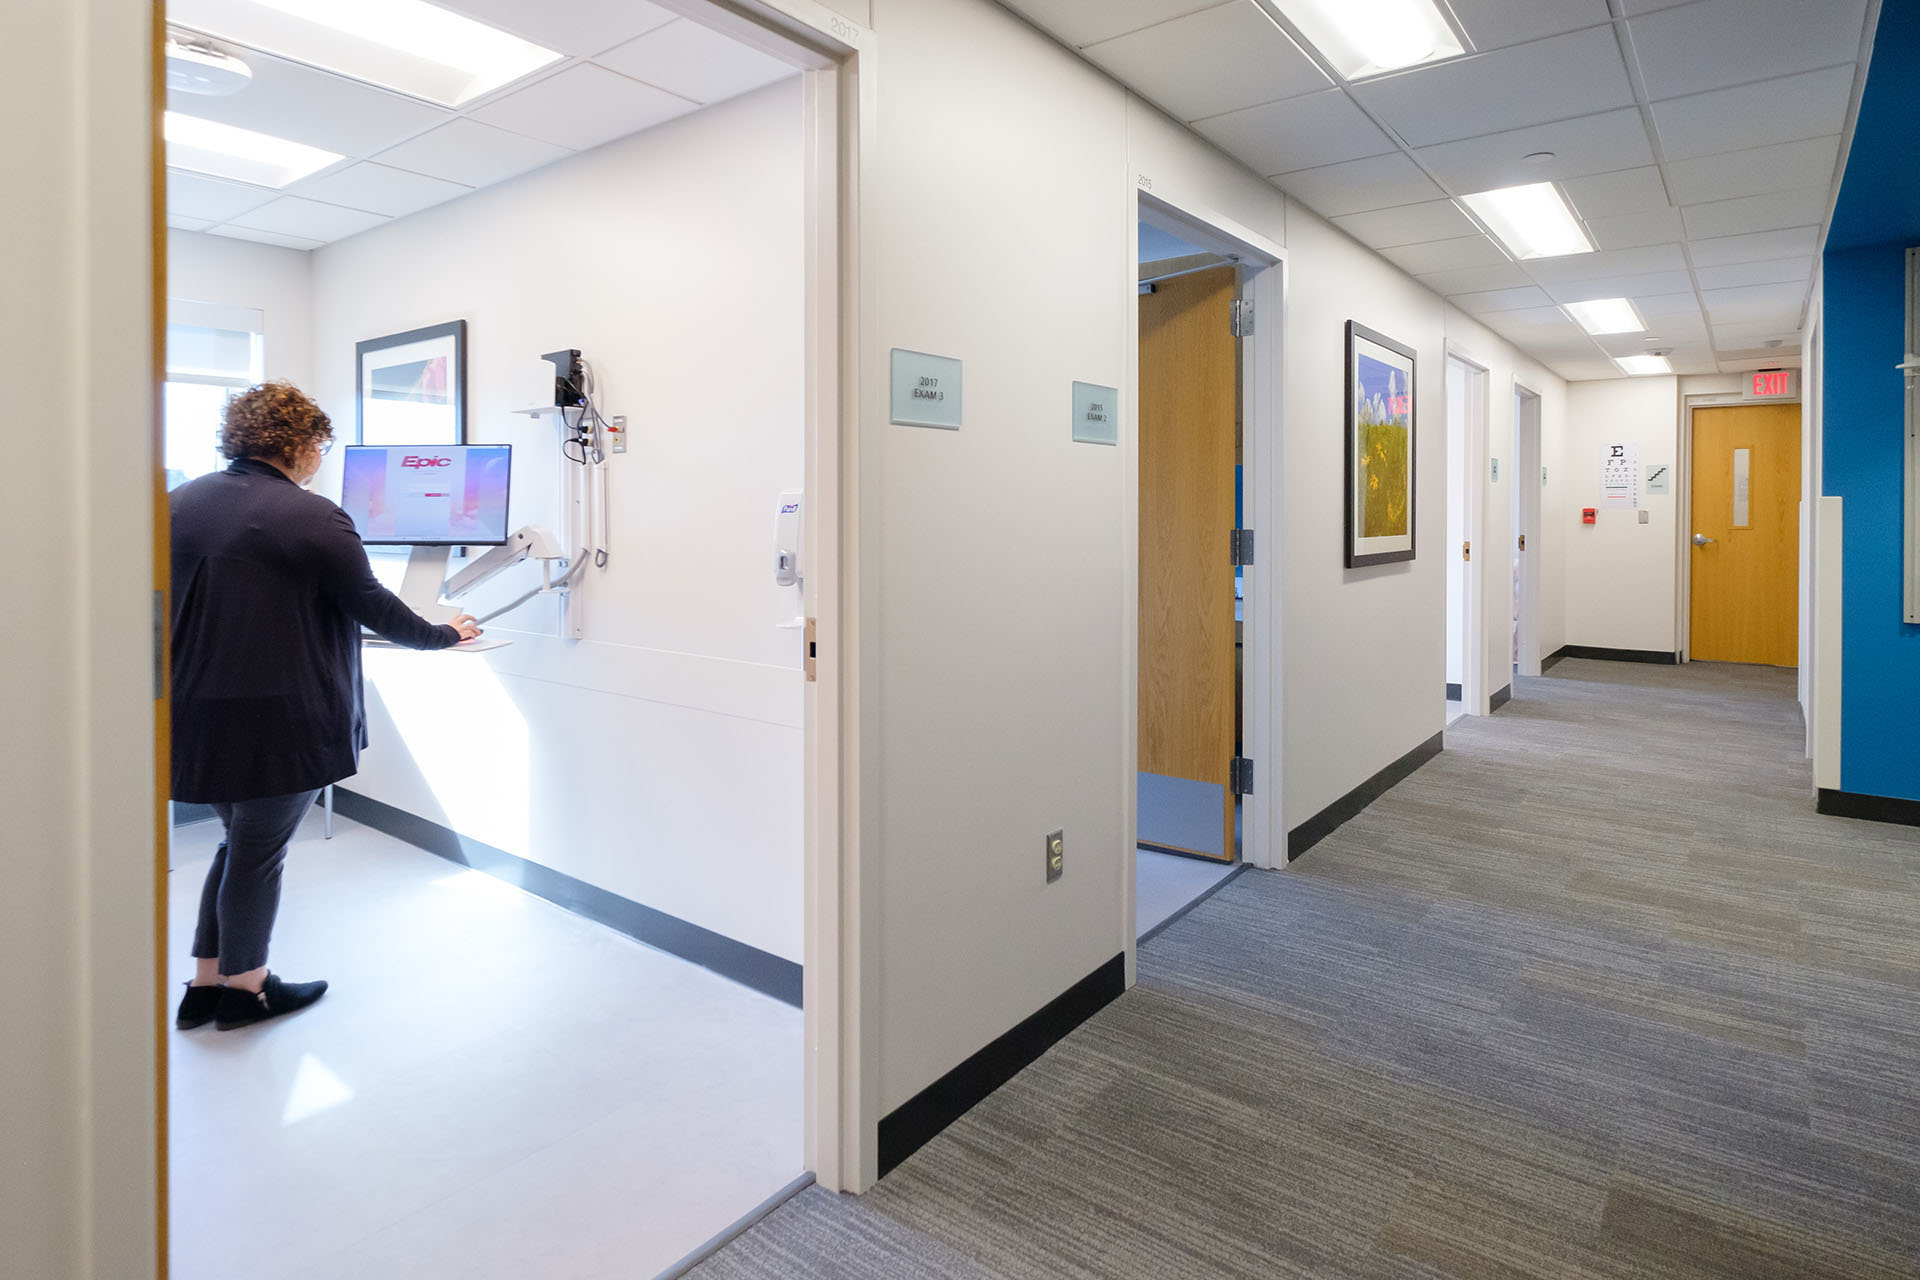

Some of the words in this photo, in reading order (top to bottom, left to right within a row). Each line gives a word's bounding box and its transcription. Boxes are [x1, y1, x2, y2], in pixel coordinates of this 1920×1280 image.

[831, 16, 860, 43] 2017
[920, 376, 938, 387] 2017
[1752, 372, 1789, 396] EXIT
[913, 388, 937, 400] EXAM
[939, 391, 944, 401] 3
[1087, 412, 1102, 421] EXAM
[1611, 445, 1624, 457] E
[400, 456, 452, 469] Epic
